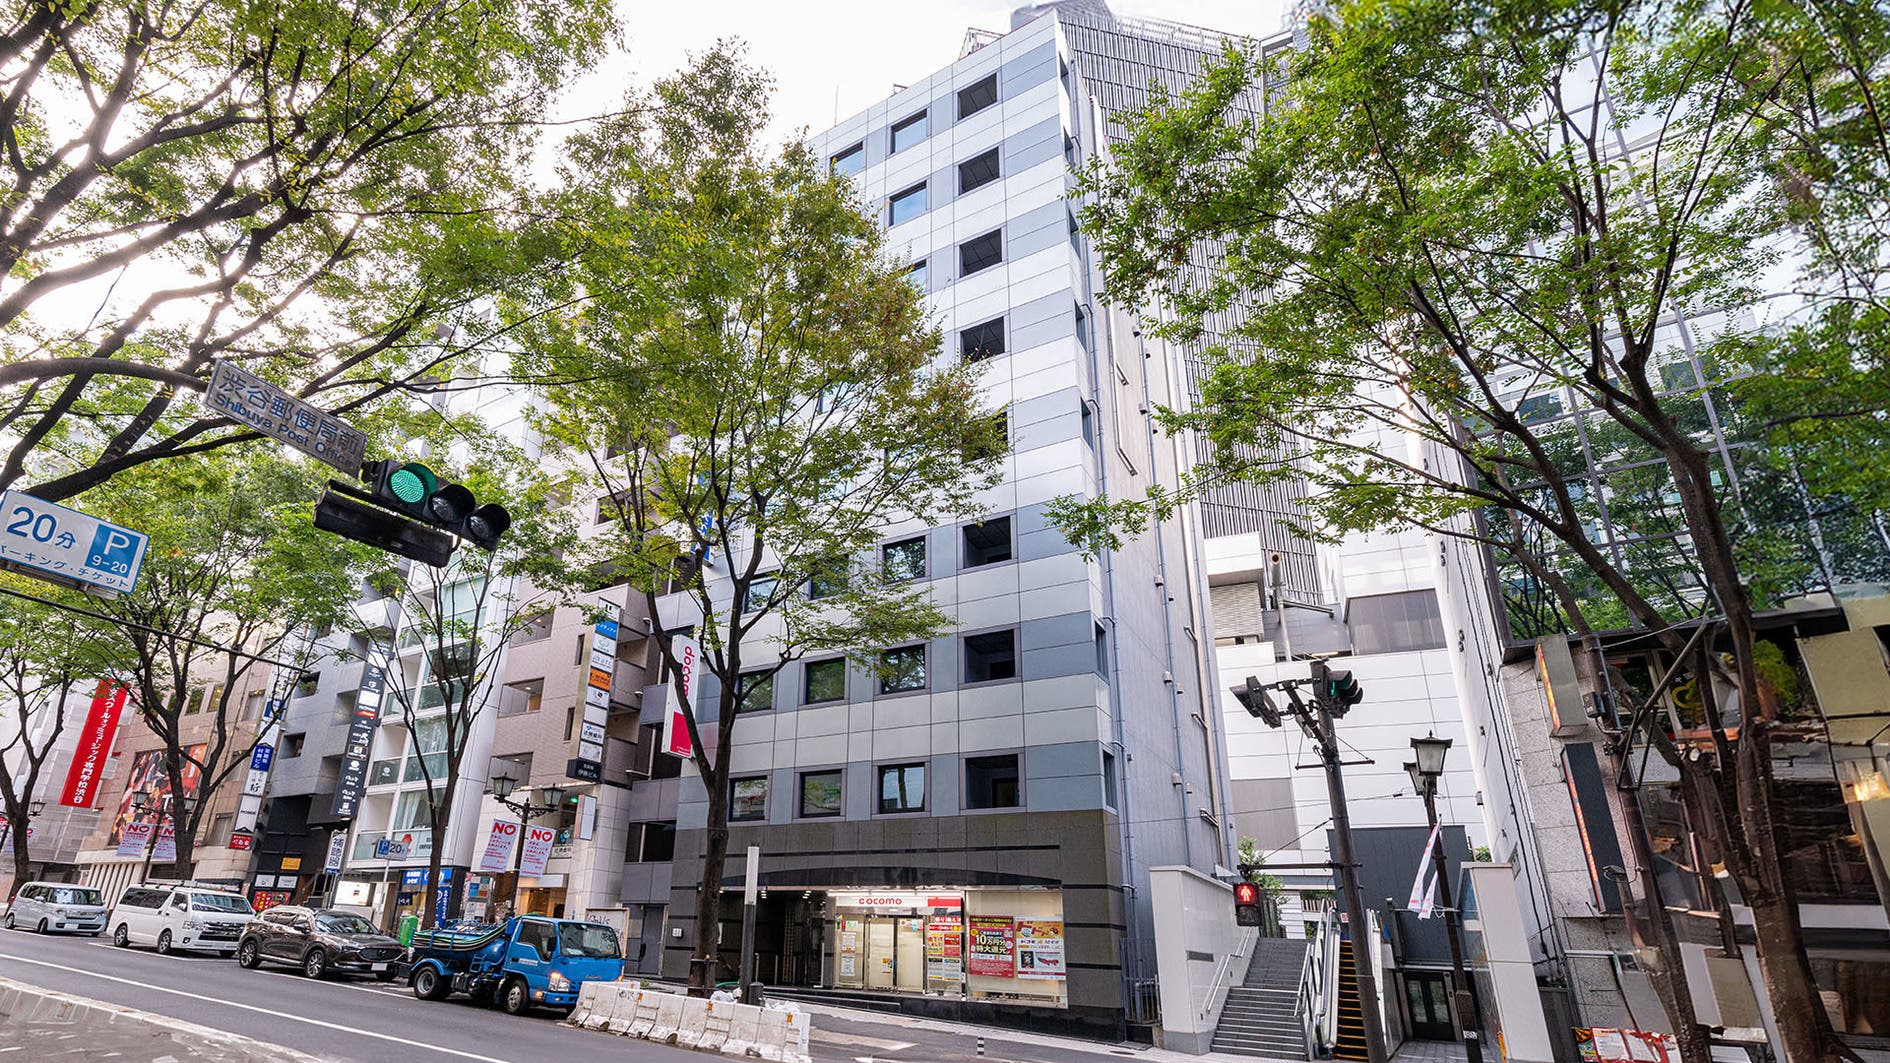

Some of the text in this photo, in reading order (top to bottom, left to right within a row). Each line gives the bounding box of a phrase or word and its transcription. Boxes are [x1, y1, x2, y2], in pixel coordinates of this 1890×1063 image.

[218, 370, 360, 455] 渋谷郵便局前
[214, 393, 355, 470] Shibuya Post Office
[6, 506, 77, 550] 20分
[103, 530, 130, 556] P
[91, 554, 128, 575] 9-20
[128, 824, 150, 833] NO
[163, 827, 176, 835] N
[493, 822, 517, 836] NO
[530, 829, 553, 843] NO
